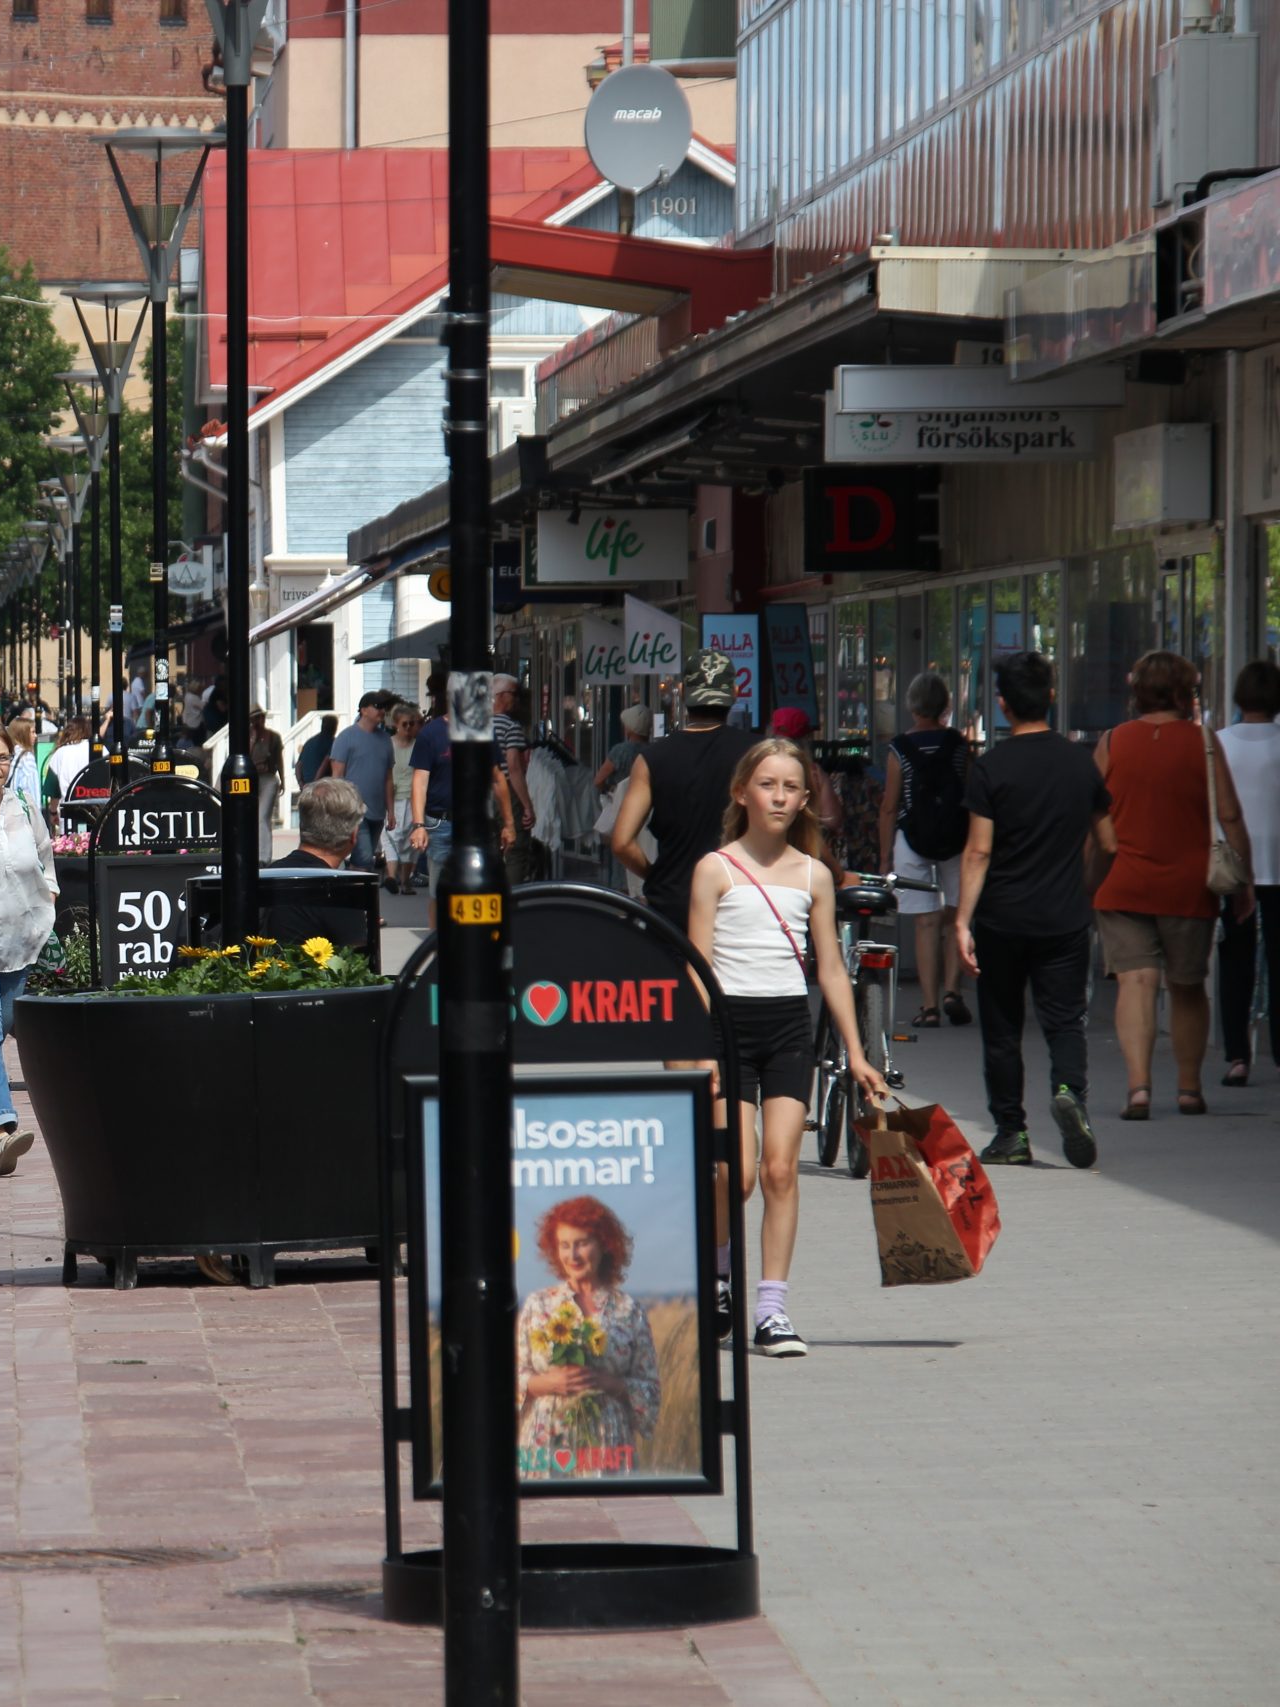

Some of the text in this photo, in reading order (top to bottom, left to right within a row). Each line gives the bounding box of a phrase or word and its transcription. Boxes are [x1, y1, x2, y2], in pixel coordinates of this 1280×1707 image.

[613, 107, 662, 120] macab
[651, 196, 696, 216] 1901
[862, 431, 889, 441] SLU
[917, 425, 1075, 454] försökspark
[824, 485, 896, 553] D
[625, 632, 677, 668] life
[710, 633, 754, 651] ALLA
[142, 811, 217, 839] STIL
[117, 890, 171, 932] 50
[455, 898, 500, 920] 499
[571, 979, 678, 1023] KRAFT
[577, 1444, 633, 1472] KRAFT
